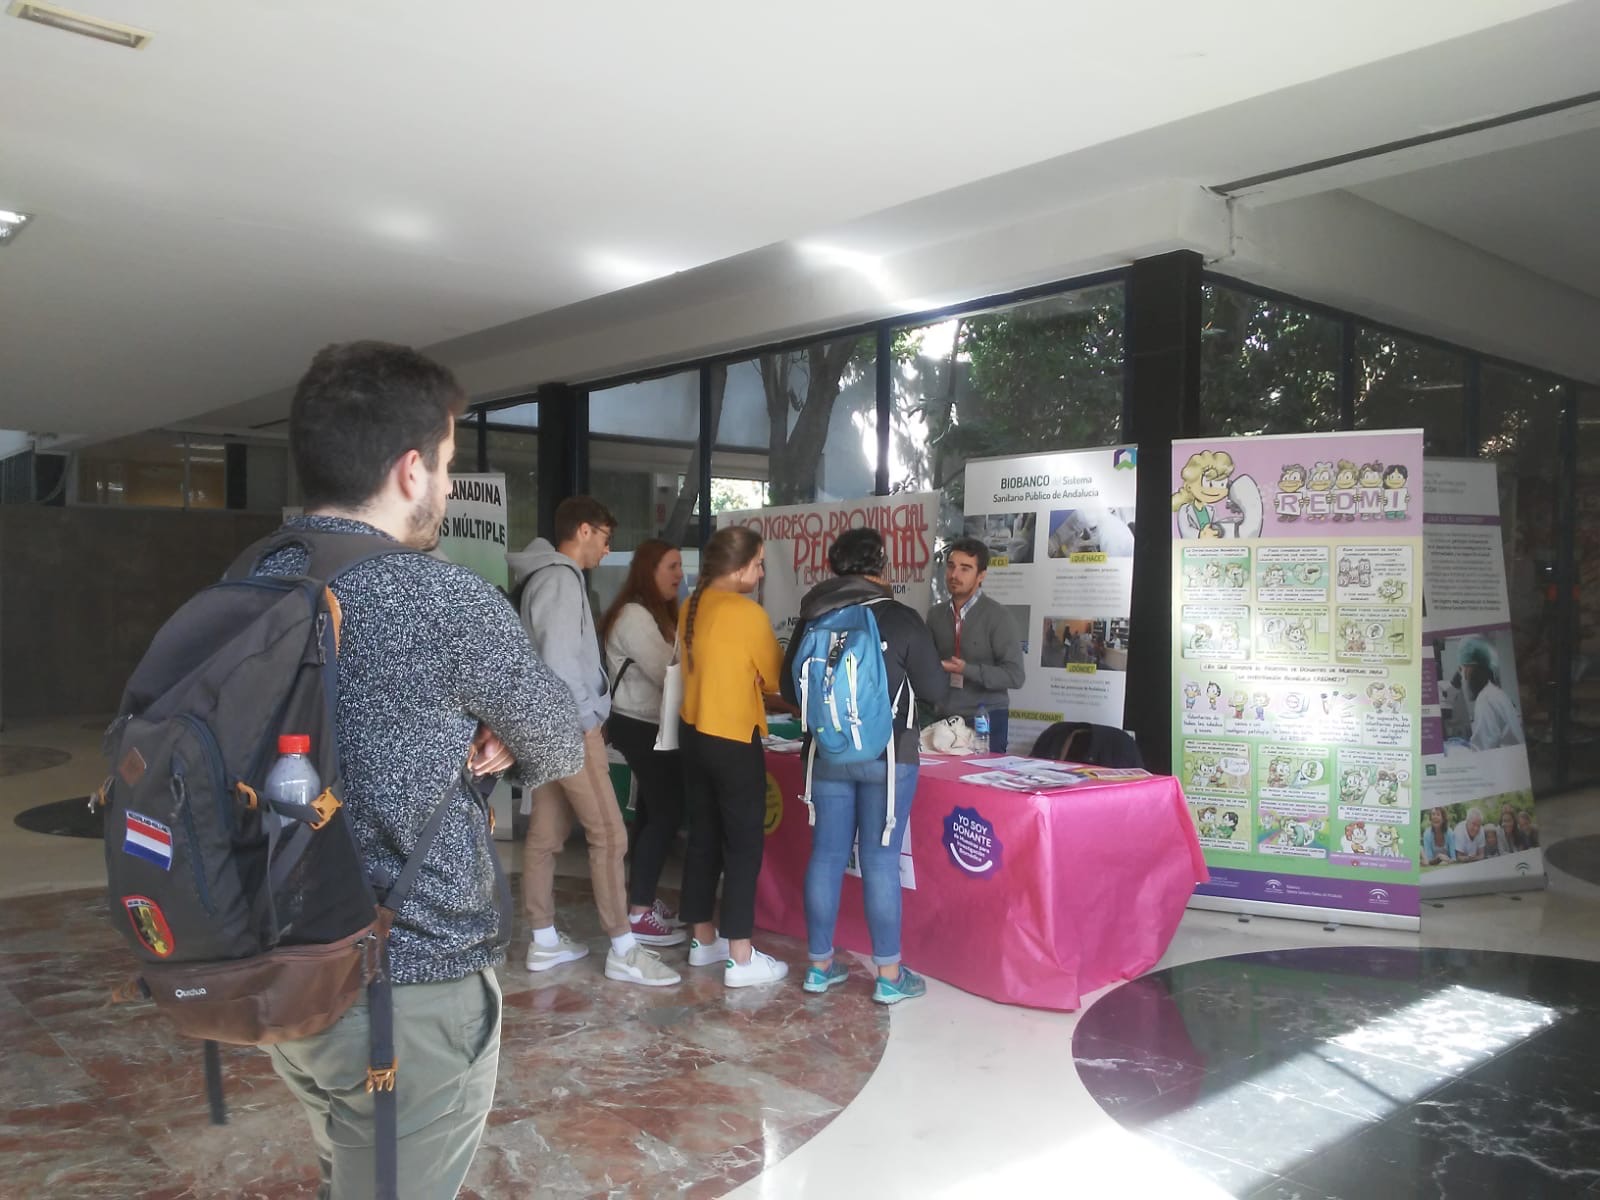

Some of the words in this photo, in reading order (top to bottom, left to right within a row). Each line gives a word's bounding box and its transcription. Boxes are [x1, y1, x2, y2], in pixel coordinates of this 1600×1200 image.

[1000, 474, 1050, 490] BIOBANCO
[1062, 475, 1093, 486] Sistema
[993, 493, 1024, 503] Sanitario
[1052, 489, 1062, 499] de
[452, 512, 506, 547] MÚLTIPLE
[953, 822, 992, 848] DONANTE
[958, 813, 969, 827] YO
[970, 820, 988, 835] SOY
